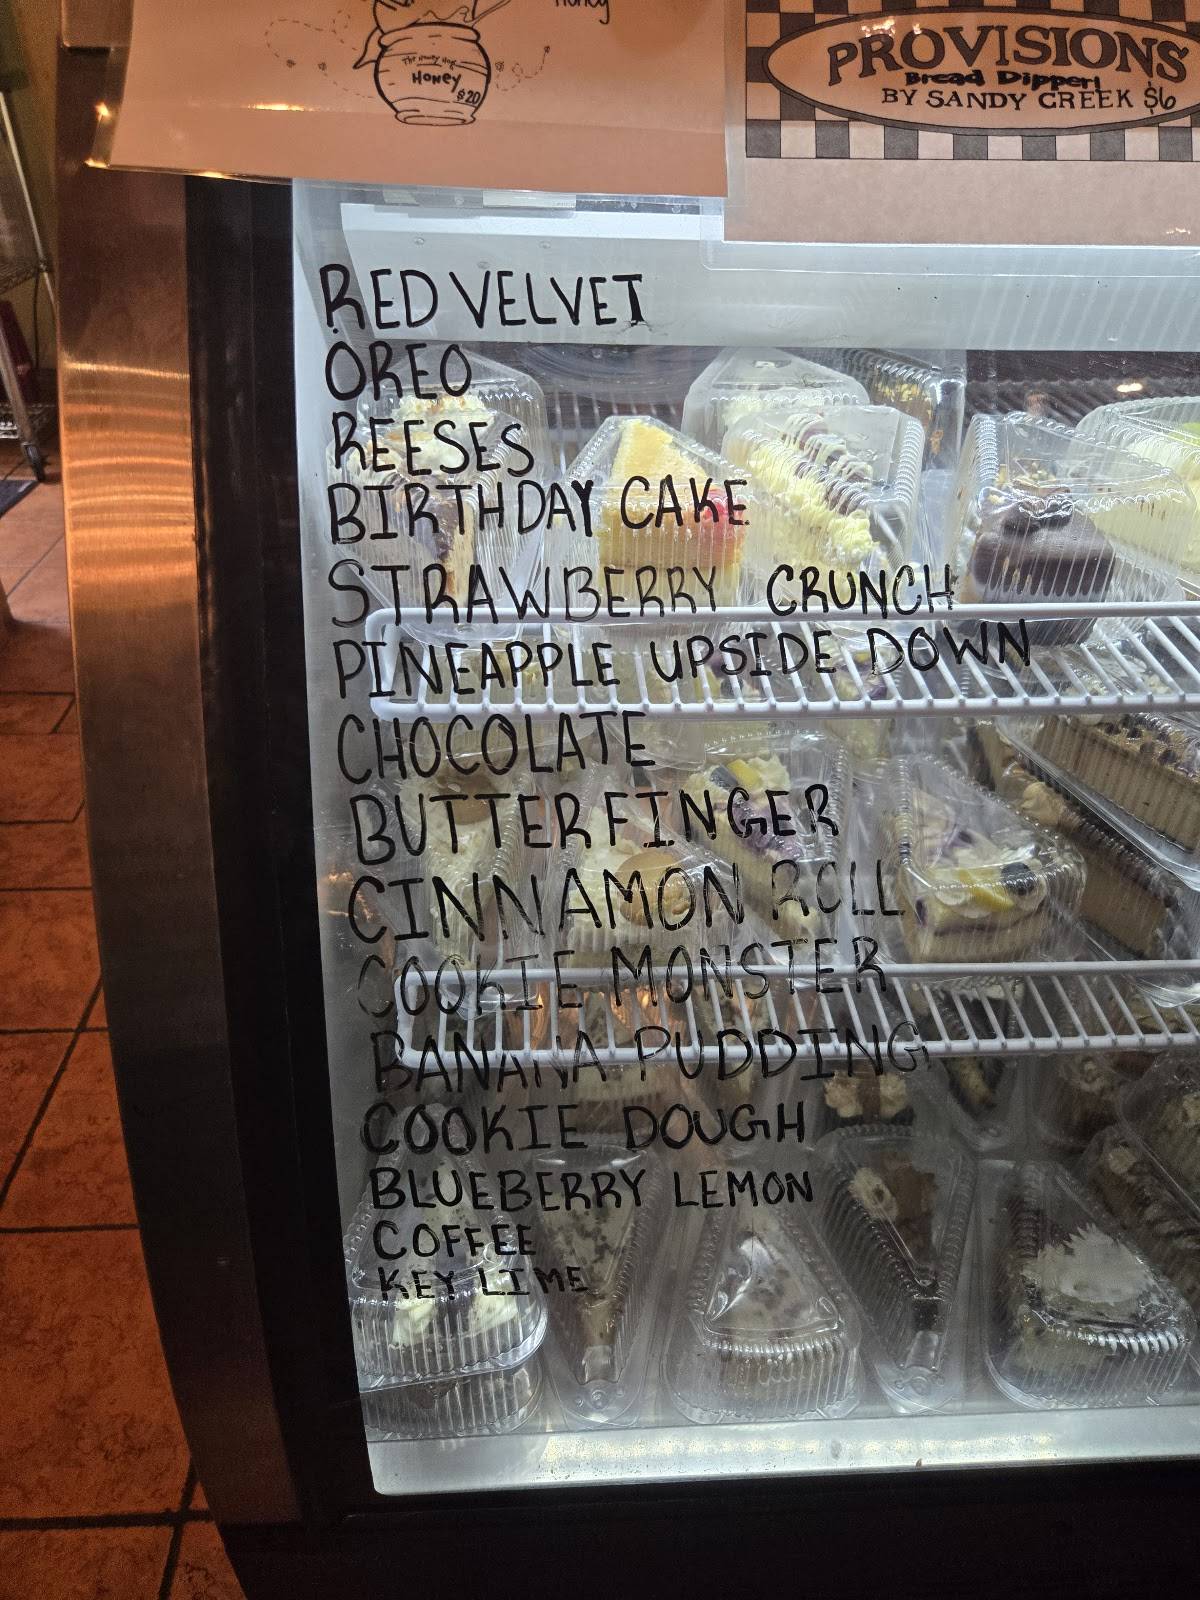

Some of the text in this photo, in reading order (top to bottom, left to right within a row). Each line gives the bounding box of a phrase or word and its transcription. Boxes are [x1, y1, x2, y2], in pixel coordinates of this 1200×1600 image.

[827, 24, 1189, 86] PROVISIONS
[905, 70, 985, 86] Bread
[457, 89, 481, 105] $20
[881, 81, 1177, 115] BY SANDY CREEK $6
[319, 263, 650, 330] RED VELVET
[324, 340, 472, 401] OREO
[331, 412, 534, 478] REESES
[327, 474, 751, 545] BIRTHDAY CAKE
[328, 558, 955, 628] STRAWBERRY CRUNCH
[333, 618, 1031, 699] PINEAPPLE UPSIDE DOWN
[337, 710, 656, 785] CHOCOLATE
[350, 783, 840, 865] BUTTERFINGER
[347, 859, 904, 943] CINNAMON ROLL
[357, 935, 887, 1018] COOKIE MONSTER
[371, 1021, 931, 1093] BANANA PUDDING
[361, 1100, 806, 1155] COOKIE DOUGH
[370, 1166, 814, 1212] BLUEBERRY LEMON
[372, 1219, 537, 1261] COFFEE
[378, 1265, 588, 1301] KEY LIME
